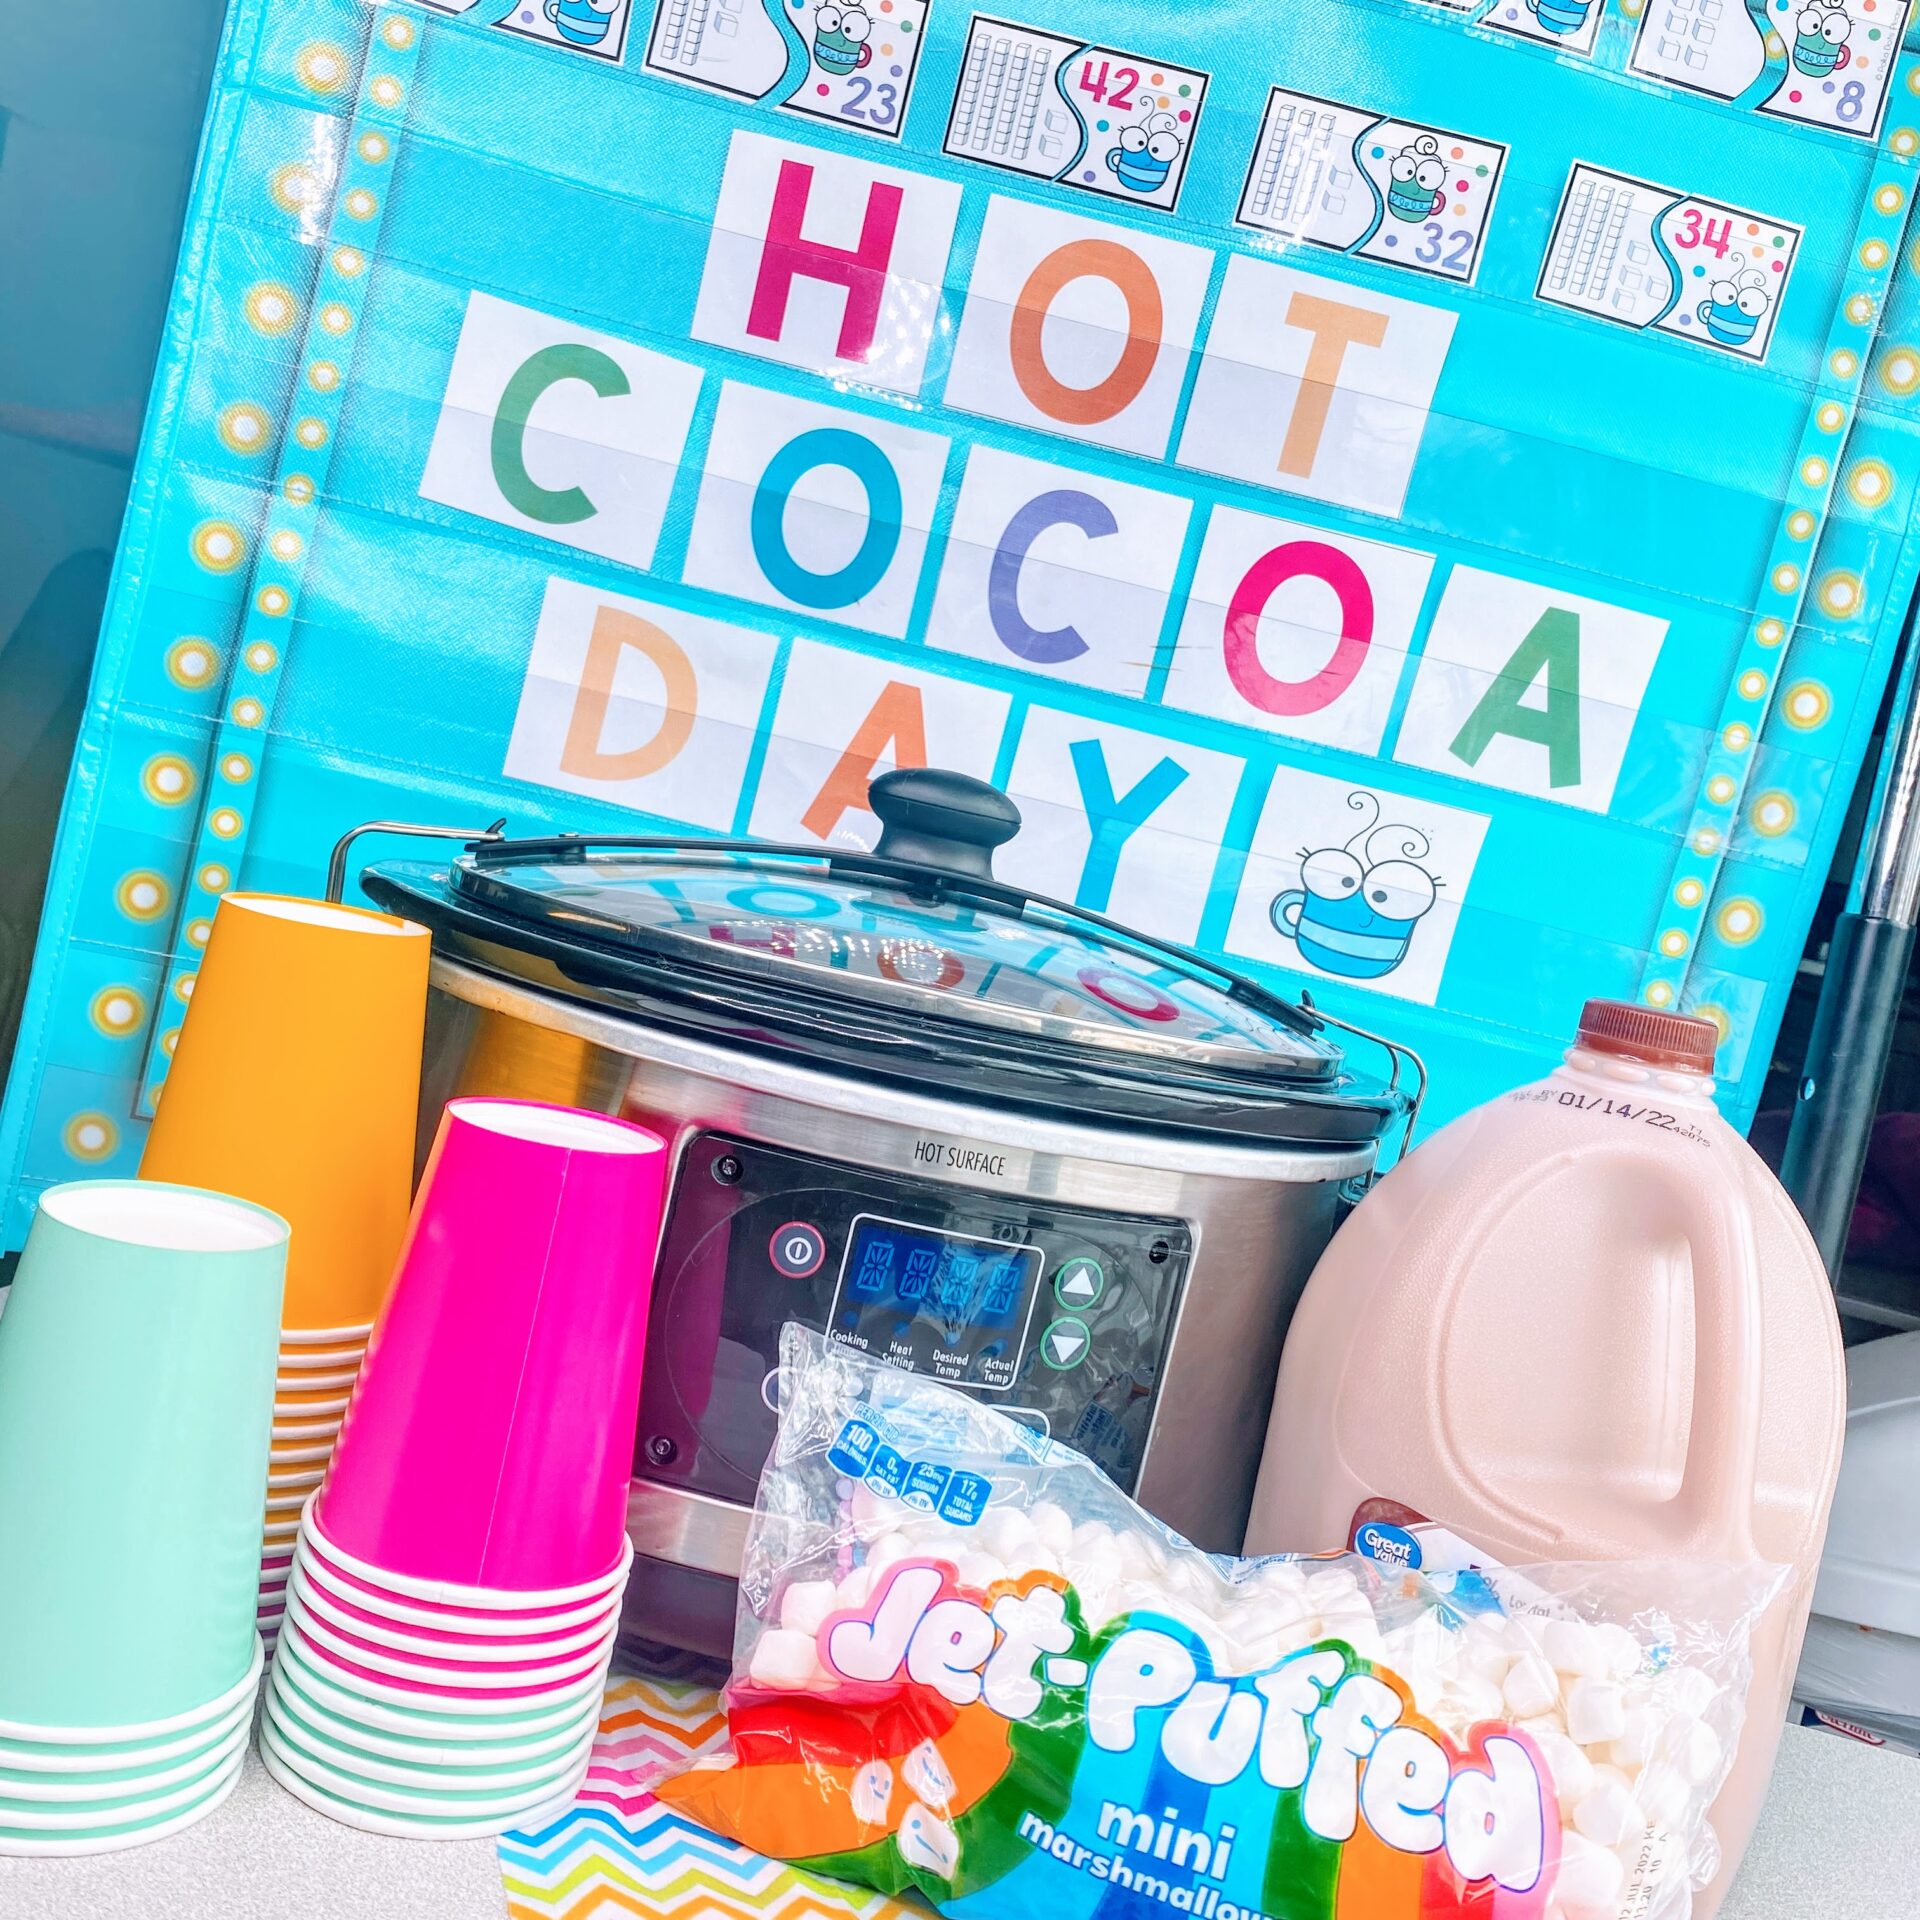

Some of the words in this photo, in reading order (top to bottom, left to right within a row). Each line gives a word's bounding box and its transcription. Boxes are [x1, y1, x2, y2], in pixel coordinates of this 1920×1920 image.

[1080, 61, 1140, 111] 42
[840, 76, 897, 125] 23
[1835, 80, 1866, 122] 8
[1415, 222, 1474, 272] 32
[1675, 209, 1733, 259] 34
[746, 159, 1390, 479] HOT
[491, 343, 1581, 789] COCOA
[560, 604, 1189, 912] DAY
[1559, 1092, 1677, 1131] 01/14/22
[914, 1140, 945, 1163] HOT
[946, 1147, 1006, 1176] SURFACE
[830, 1329, 868, 1349] Cooking
[889, 1341, 912, 1356] Heat
[882, 1352, 914, 1371] Setting
[932, 1350, 969, 1366] Desired
[936, 1363, 961, 1378] Temp
[984, 1358, 1014, 1372] Actual
[984, 1370, 1009, 1385] Temp
[855, 1404, 872, 1420] PER
[884, 1420, 899, 1441] CUP
[846, 1424, 873, 1452] 100
[836, 1440, 867, 1466] CALORIES
[874, 1464, 886, 1478] SAT
[886, 1473, 898, 1485] FAT
[911, 1477, 939, 1495] SODIUM
[918, 1464, 945, 1484] 25mg
[961, 1479, 978, 1501] 17g
[944, 1507, 973, 1522] SUGARS
[952, 1496, 973, 1512] TOTAL
[1364, 1528, 1412, 1560] Great
[1373, 1549, 1409, 1567] Value
[828, 1566, 1544, 1892] Jet-Puffed
[1096, 1800, 1237, 1881] mini
[1634, 1845, 1652, 1875] 2022
[1626, 1880, 1643, 1902] JUL
